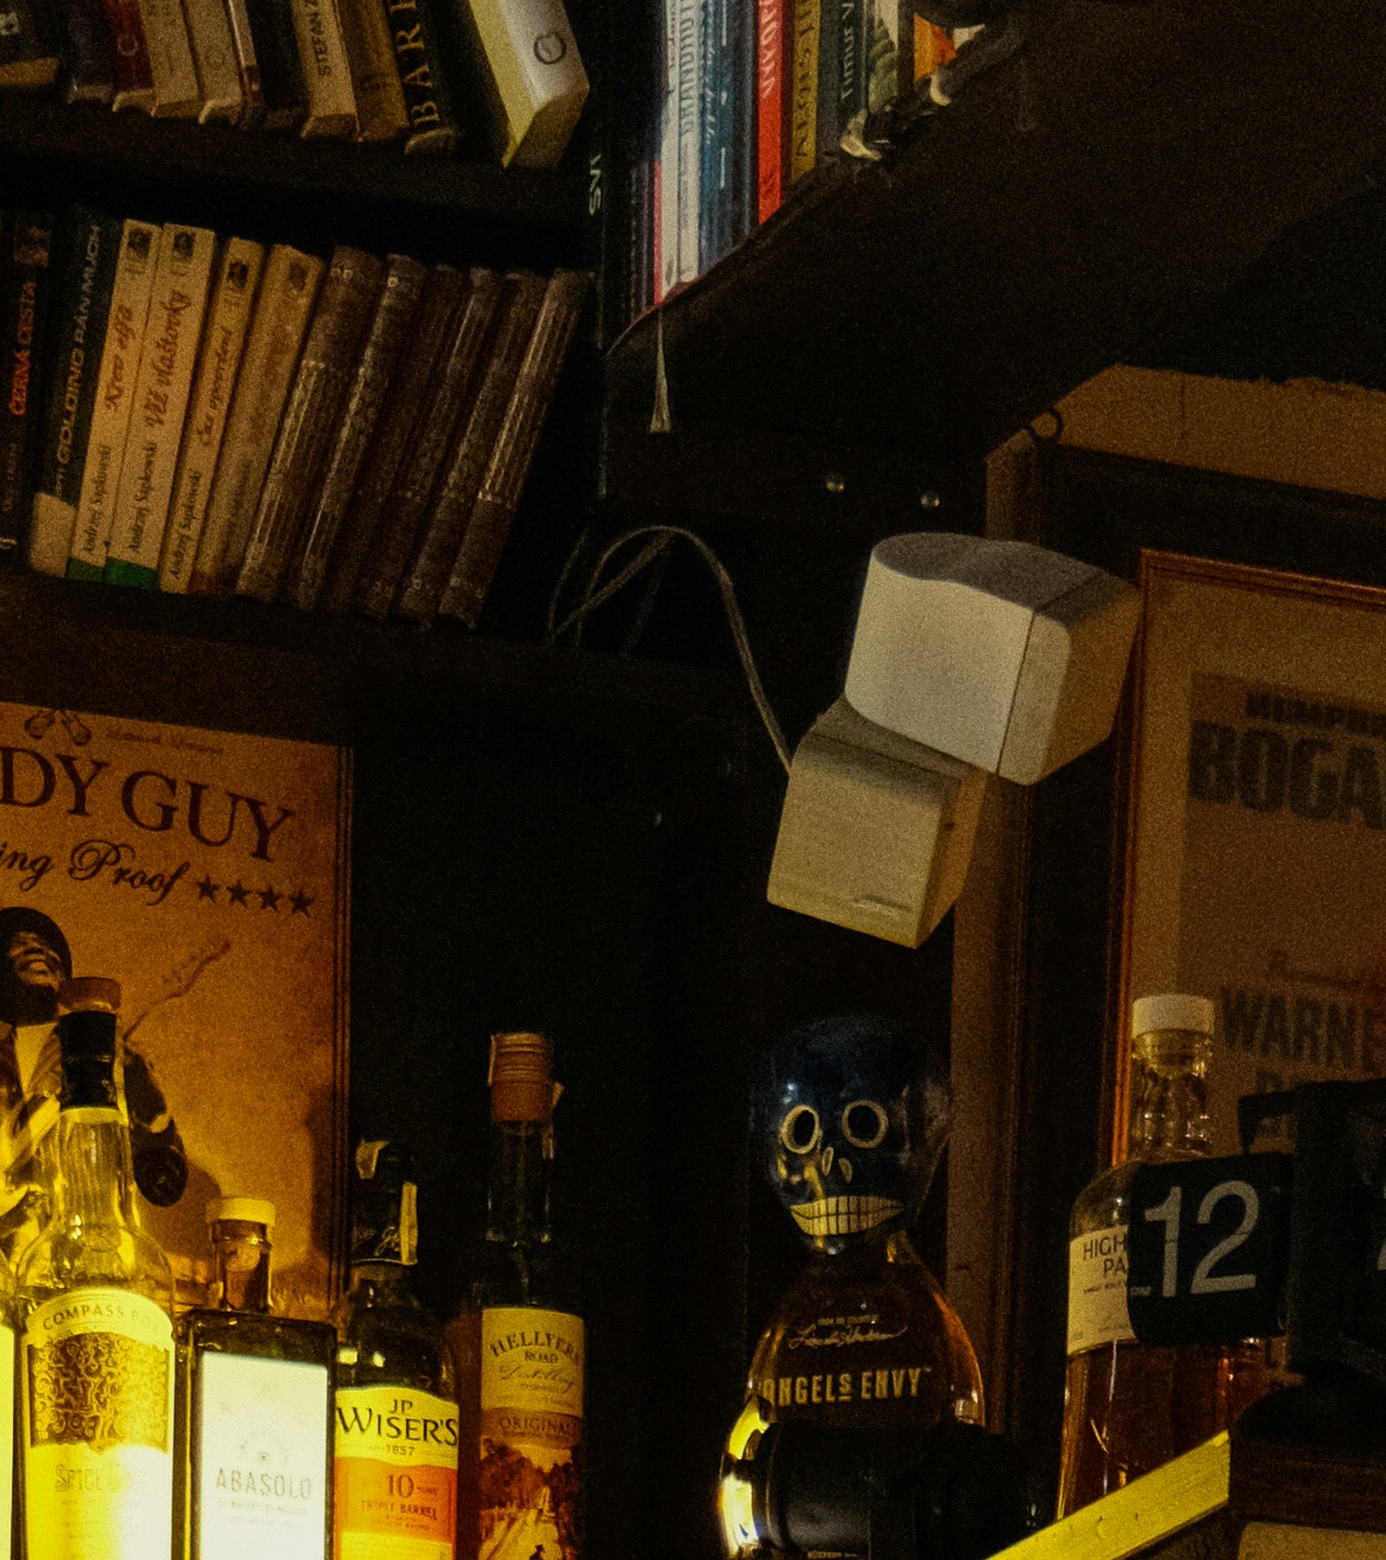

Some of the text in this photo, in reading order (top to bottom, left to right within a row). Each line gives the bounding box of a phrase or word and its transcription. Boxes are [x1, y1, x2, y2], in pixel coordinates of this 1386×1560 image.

[56, 347, 86, 465] GOLDING
[120, 770, 297, 863] GUY
[68, 838, 191, 906] Proof
[1083, 1233, 1127, 1262] HIGH
[1145, 1180, 1260, 1298] 12
[42, 1303, 125, 1332] COMPASS
[860, 1366, 923, 1400] ENVY
[389, 1398, 413, 1416] JP
[337, 1406, 458, 1447] WISER'S
[214, 1467, 314, 1501] ABASOLO
[388, 1474, 414, 1499] 10
